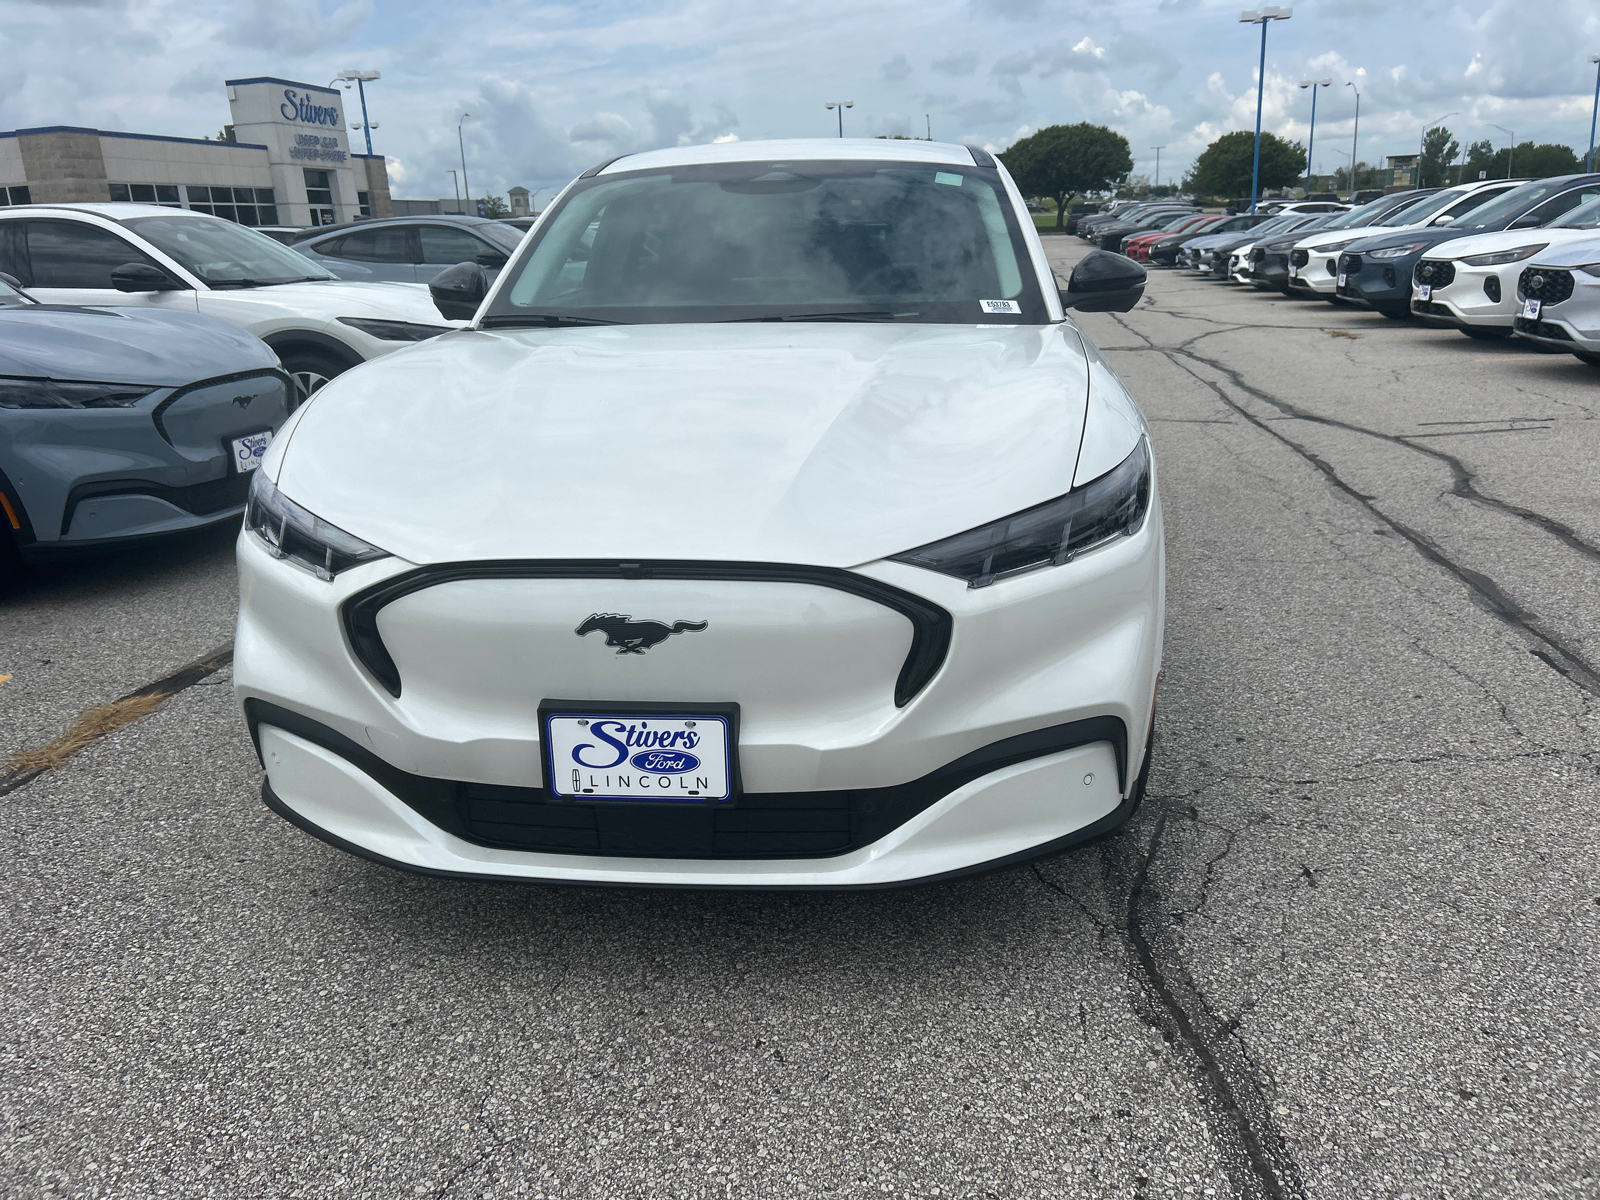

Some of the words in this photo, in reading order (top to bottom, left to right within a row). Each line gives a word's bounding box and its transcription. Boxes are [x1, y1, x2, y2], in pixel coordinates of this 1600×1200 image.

[281, 89, 339, 127] Stivers
[294, 134, 320, 147] USED
[320, 136, 339, 149] CAR
[238, 436, 268, 460] Stivers
[571, 720, 701, 769] Stivers
[645, 752, 686, 770] Ford
[590, 775, 708, 789] LINCOLN
